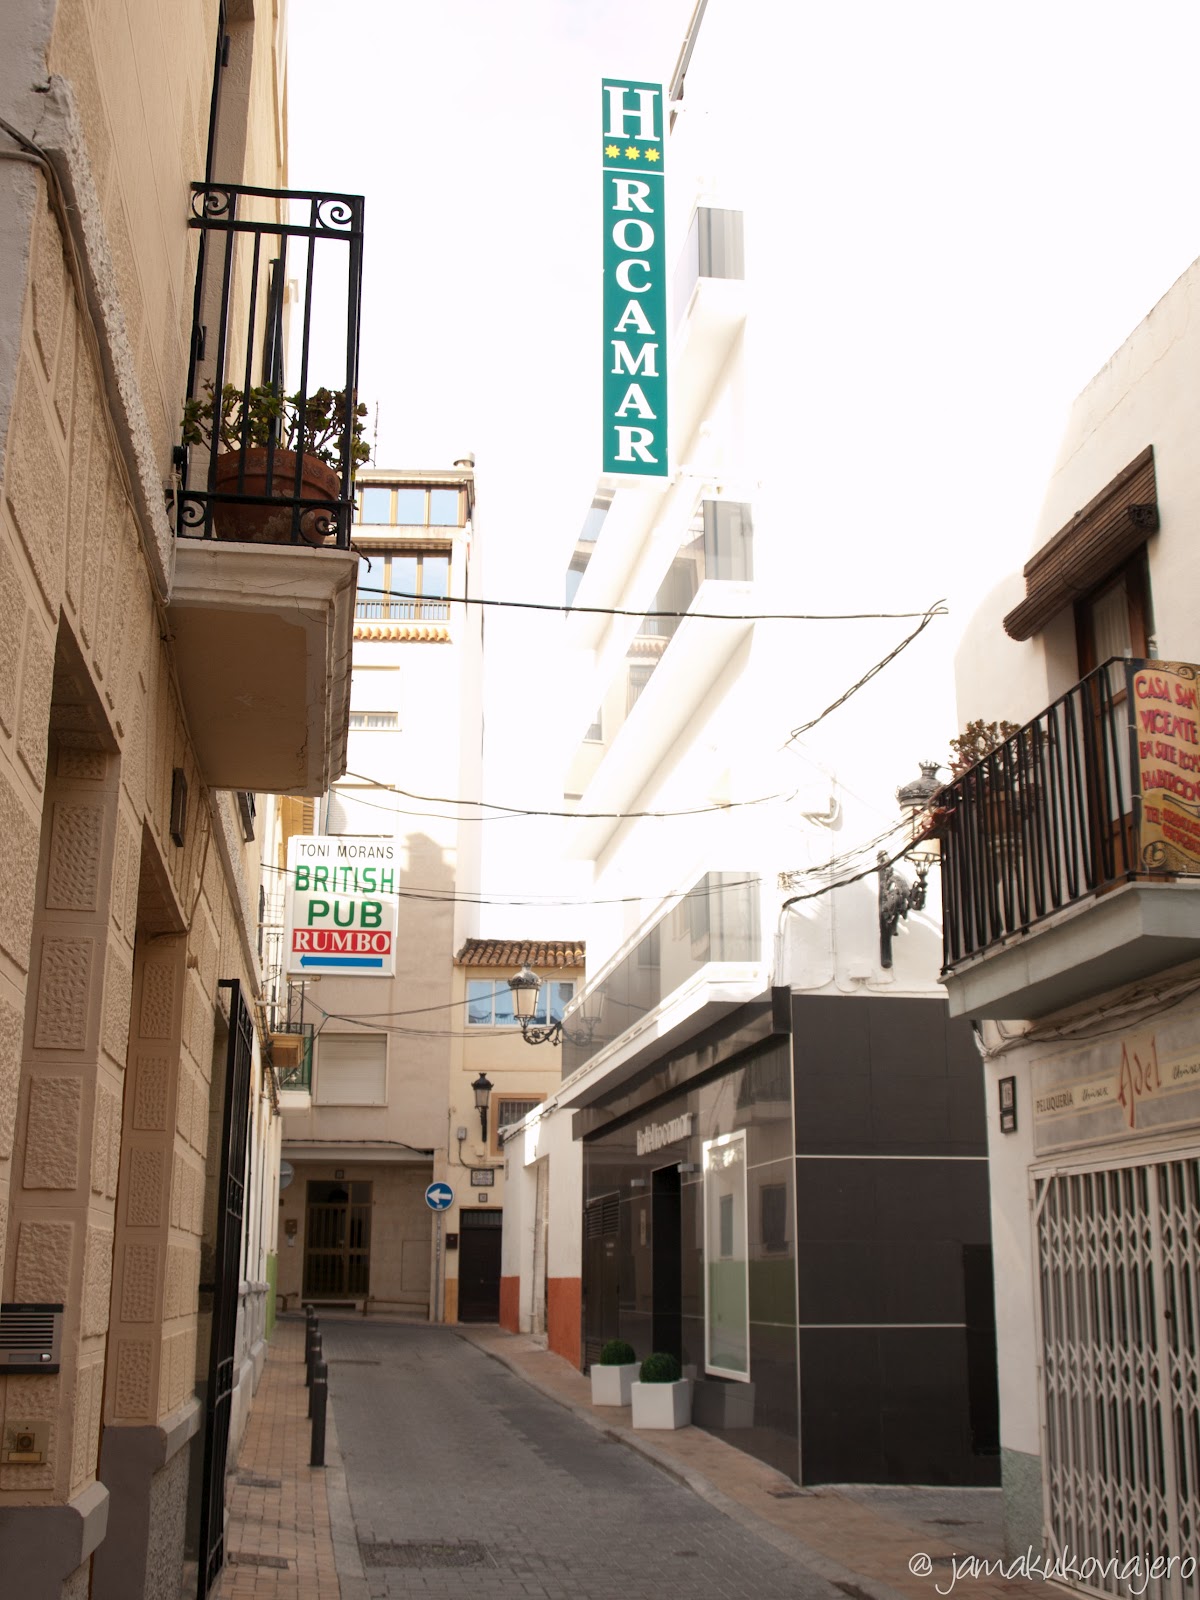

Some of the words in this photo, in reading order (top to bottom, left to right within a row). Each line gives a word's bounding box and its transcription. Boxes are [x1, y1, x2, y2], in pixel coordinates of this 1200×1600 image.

[603, 85, 660, 142] H
[611, 178, 659, 463] ROCAMAR
[1136, 676, 1172, 702] CASA
[1175, 683, 1199, 710] SAN
[1139, 708, 1199, 745] VICENTE
[300, 844, 330, 857] TONI
[337, 845, 394, 859] MORANS
[295, 865, 394, 894] BRITISH
[307, 900, 383, 928] PUB
[294, 931, 390, 953] RUMBO
